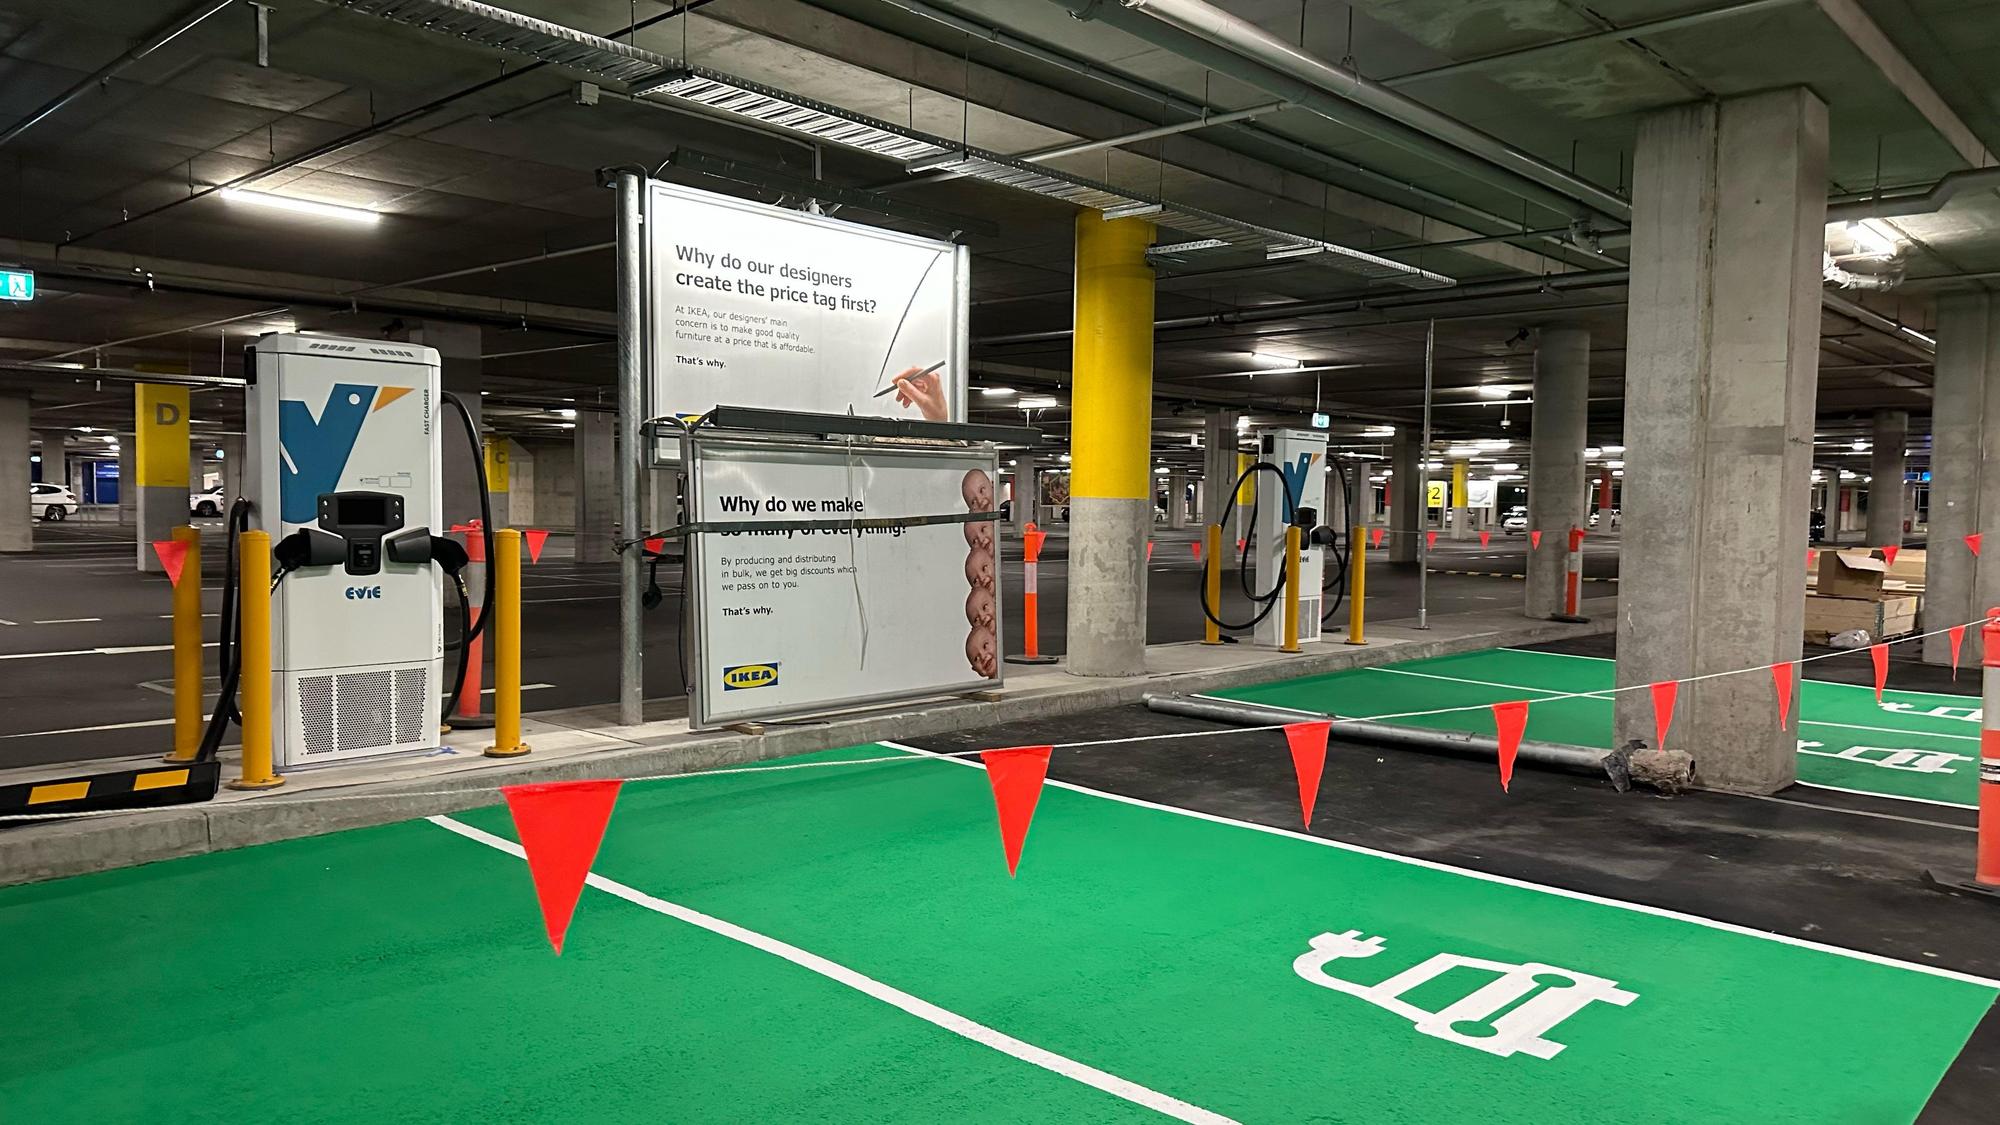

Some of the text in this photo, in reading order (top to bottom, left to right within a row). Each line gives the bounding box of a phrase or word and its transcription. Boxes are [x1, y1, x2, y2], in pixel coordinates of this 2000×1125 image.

[675, 244, 852, 288] Why do our designers
[675, 272, 877, 313] create the price tag first?
[675, 305, 685, 314] At
[687, 306, 710, 318] IKEA,
[713, 311, 727, 319] our
[769, 318, 788, 327] main
[675, 319, 800, 341] concern is to make good quality
[675, 330, 712, 342] furniture
[733, 338, 752, 346] price
[754, 340, 769, 348] that
[779, 343, 816, 354] affordable.
[706, 358, 727, 369] why.
[156, 402, 180, 426] D
[495, 451, 505, 464] C
[719, 495, 863, 516] Why do we make
[721, 554, 836, 567] By producing and distributing
[721, 565, 858, 578] in bulk, we get big discounts which
[721, 581, 800, 592] we pass on to you.
[752, 605, 774, 616] why.
[731, 669, 773, 683] IKEA
